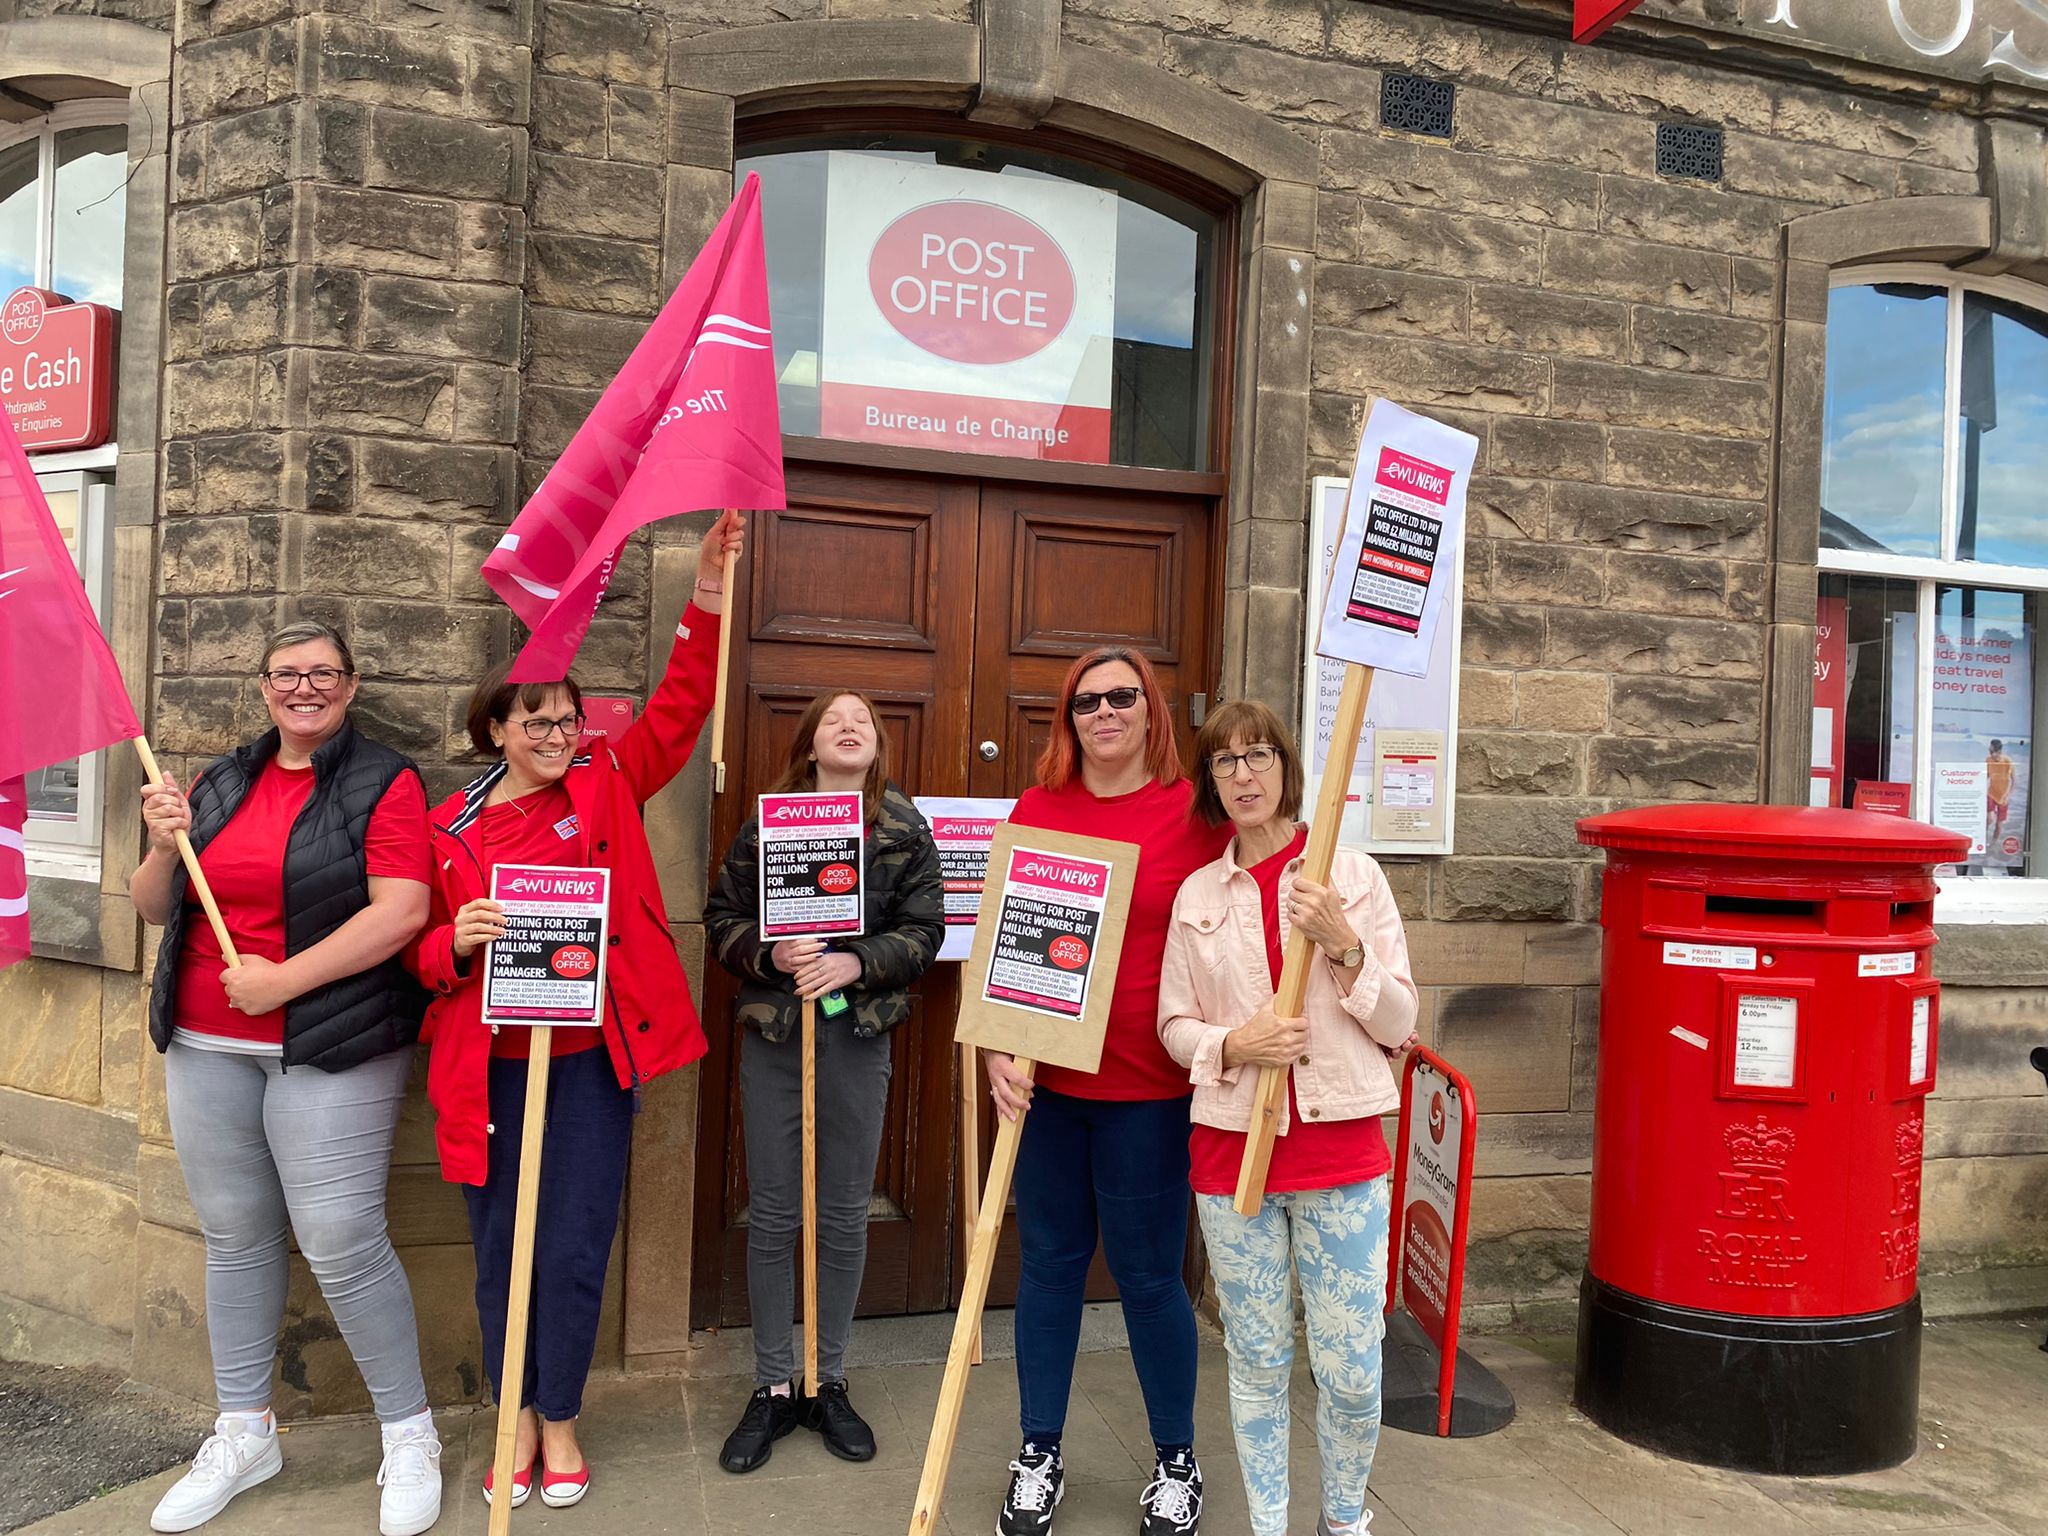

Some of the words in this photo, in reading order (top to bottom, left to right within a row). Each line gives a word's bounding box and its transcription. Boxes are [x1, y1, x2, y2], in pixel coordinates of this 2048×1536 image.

[921, 232, 1035, 280] POST
[12, 300, 36, 316] POST
[890, 275, 1048, 328] OFFICE
[6, 317, 39, 333] OFFICE
[23, 347, 81, 391] Cash
[3, 398, 47, 415] thdrawals
[22, 415, 63, 433] Enquiries
[865, 404, 946, 433] Bureau
[956, 415, 981, 435] de
[990, 418, 1069, 447] Change
[1415, 471, 1446, 495] NEWS
[1372, 504, 1389, 518] POST
[1388, 509, 1408, 525] OFFICE
[1408, 516, 1419, 528] LTD
[1419, 520, 1428, 531] TO
[1428, 523, 1440, 535] PAY
[1374, 519, 1390, 535] OVER
[1389, 524, 1399, 538] £2
[1399, 527, 1424, 546] MILLION
[1424, 536, 1433, 547] TO
[1366, 532, 1399, 551] MANAGERS
[1399, 543, 1408, 554] IN
[1408, 546, 1435, 562] BONUSES
[1362, 552, 1372, 562] BUT
[1372, 555, 1395, 569] NOTHING
[1394, 561, 1404, 571] FOR
[1322, 657, 1347, 667] Trave
[1936, 649, 1973, 662] idays
[1976, 653, 2011, 664] need
[1933, 665, 1961, 676] reat
[1965, 666, 2004, 679] travel
[1933, 681, 1968, 694] oney
[1971, 685, 2007, 695] rates
[583, 728, 608, 736] hours
[1941, 769, 1980, 777] Customer
[770, 805, 813, 820] CWU
[814, 804, 852, 818] NEWS
[971, 825, 995, 835] NEW
[766, 841, 807, 853] NOTHING
[808, 840, 826, 851] FOR
[827, 839, 849, 850] POST
[766, 853, 796, 864] OFFICE
[797, 851, 838, 863] WORKERS
[839, 850, 856, 861] BUT
[939, 852, 951, 860] OST
[951, 852, 971, 860] OFFICE
[971, 852, 982, 860] LTD
[767, 864, 809, 875] MILLIONS
[827, 868, 850, 877] POST
[940, 861, 956, 869] OVER
[956, 861, 964, 869] £2
[965, 861, 988, 870] MILLIO
[767, 876, 784, 886] FOR
[942, 870, 969, 878] ANAGERS
[970, 870, 977, 878] IN
[1018, 862, 1060, 880] CWU
[1060, 868, 1100, 888] NEWS
[504, 877, 552, 893] CWU
[553, 879, 596, 895] NEWS
[822, 877, 853, 886] OFFICE
[767, 886, 815, 898] MANAGERS
[1006, 897, 1046, 914] NOTHING
[1046, 904, 1064, 917] FOR
[1065, 907, 1087, 921] POST
[503, 917, 545, 928] OTHING
[544, 918, 563, 929] FOR
[565, 919, 589, 930] POST
[1004, 910, 1032, 925] OFFICE
[1033, 915, 1074, 933] WORKERS
[1075, 923, 1093, 936] BUT
[529, 930, 576, 942] WORKERS
[577, 932, 596, 942] BUT
[1002, 922, 1043, 939] MILLIONS
[495, 941, 542, 953] MILLIONS
[1000, 934, 1017, 946] FOR
[1059, 941, 1082, 952] POST
[494, 953, 513, 964] FOR
[562, 951, 587, 960] POST
[997, 946, 1044, 964] MANAGERS
[1052, 949, 1084, 963] OFFICE
[1691, 956, 1722, 964] POSTBOX
[493, 966, 547, 978] MANAGERS
[555, 960, 591, 970] OFFICE
[1413, 1142, 1456, 1199] MoneyGram
[1411, 1222, 1424, 1249] Fast
[1424, 1241, 1437, 1263] and
[1436, 1255, 1447, 1275] saf
[1697, 1228, 1808, 1261] ROYAL
[1406, 1241, 1427, 1277] money
[1427, 1263, 1447, 1296] transf
[1707, 1257, 1798, 1288] MAIL
[1408, 1263, 1435, 1305] available
[1434, 1291, 1445, 1318] her
